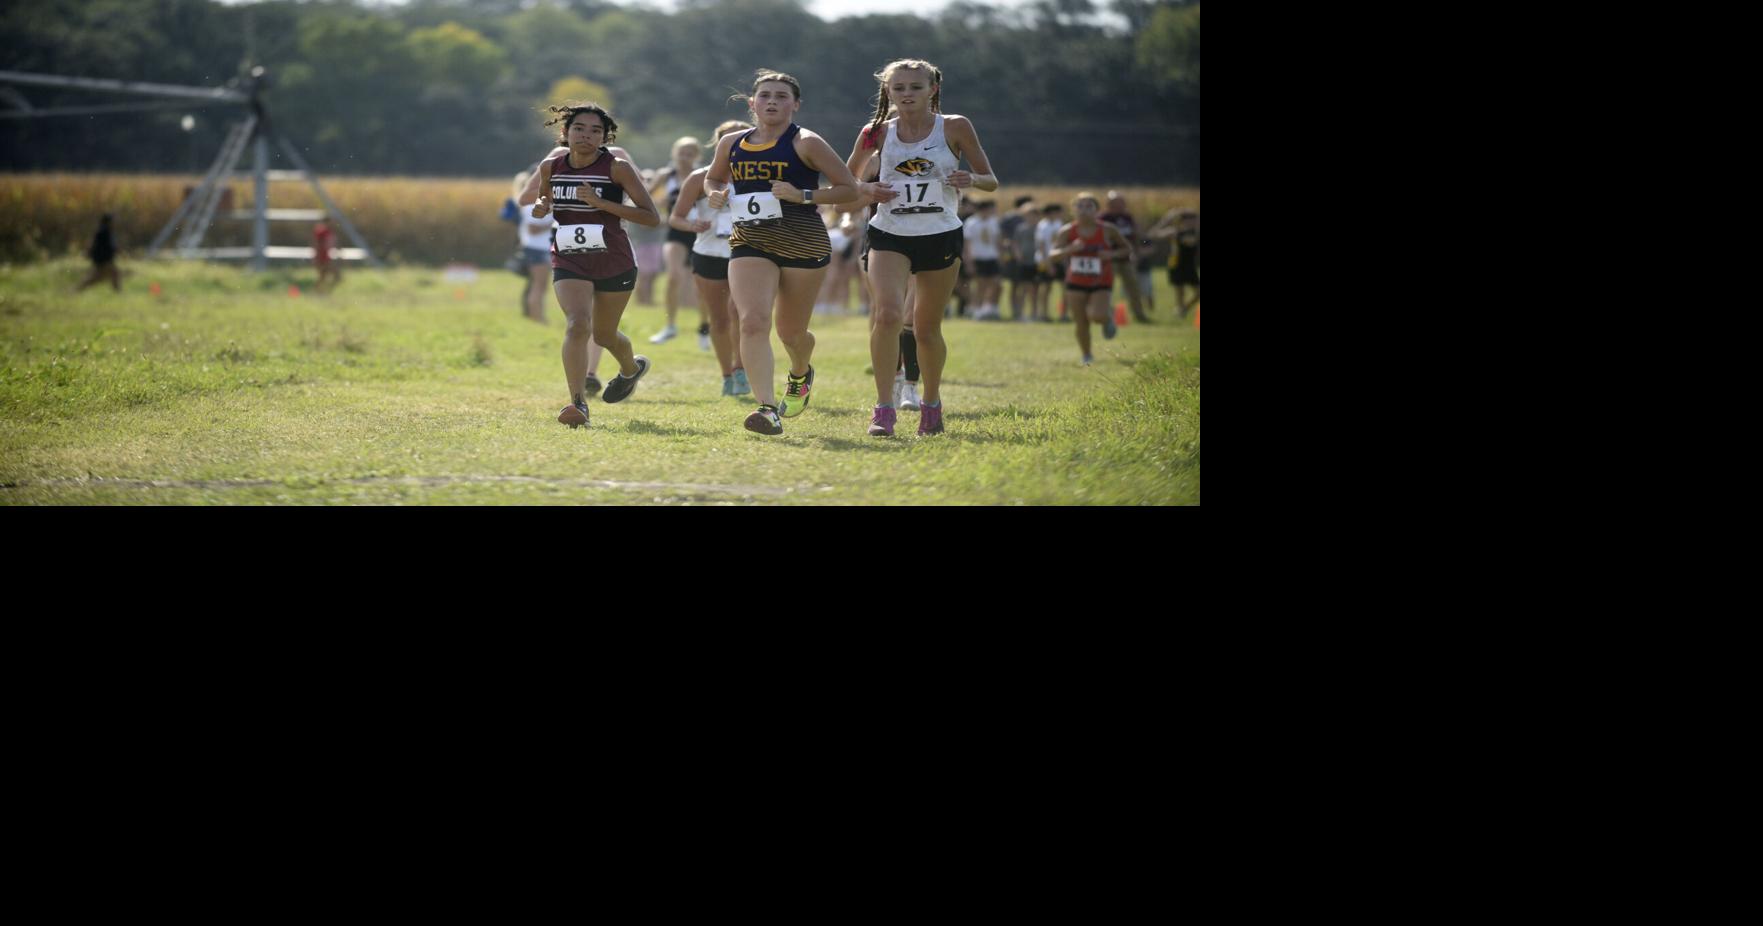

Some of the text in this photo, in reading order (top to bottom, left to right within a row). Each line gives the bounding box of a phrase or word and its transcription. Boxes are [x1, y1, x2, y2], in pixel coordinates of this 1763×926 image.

[730, 161, 788, 180] WEST
[905, 183, 929, 202] 17
[748, 196, 760, 215] 6
[574, 227, 586, 244] 8
